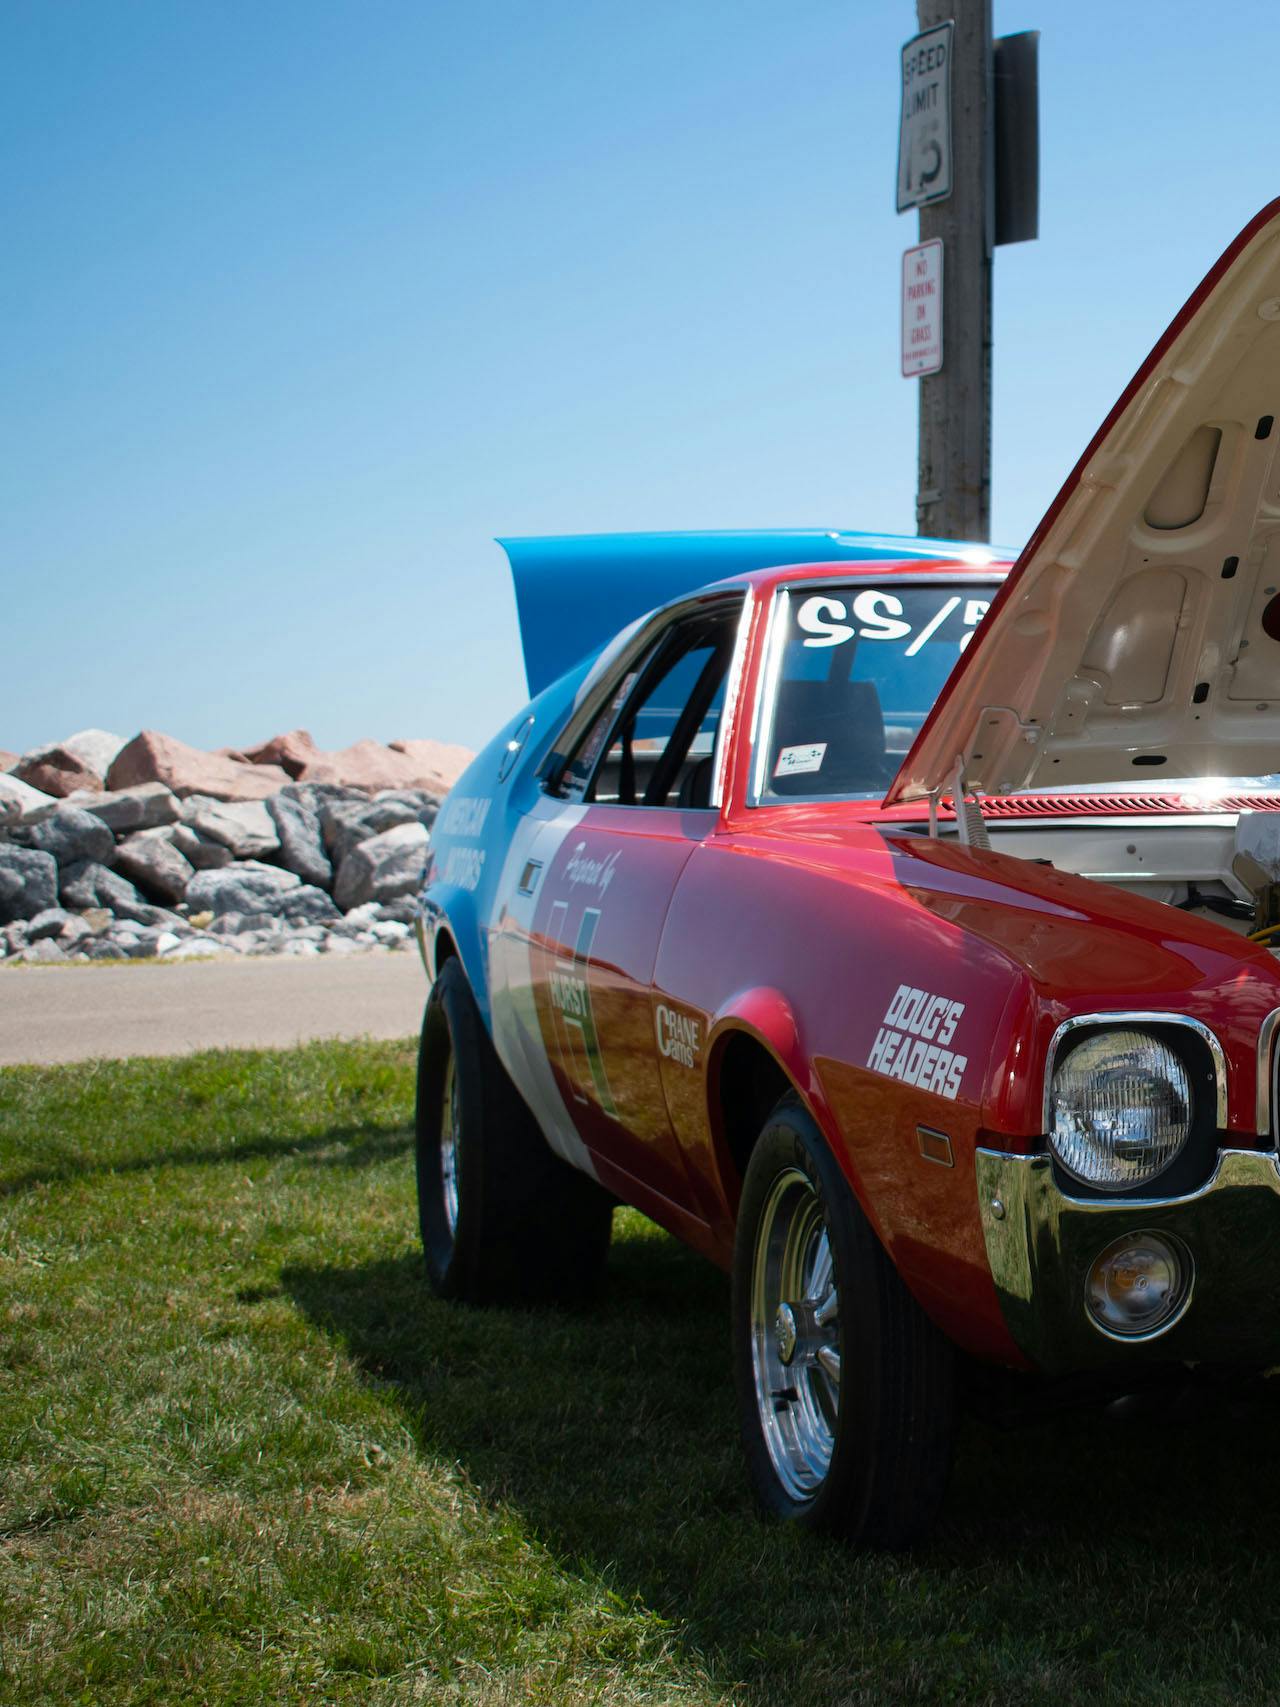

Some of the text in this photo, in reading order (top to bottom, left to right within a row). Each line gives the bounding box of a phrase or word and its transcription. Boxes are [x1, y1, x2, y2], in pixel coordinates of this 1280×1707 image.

[904, 43, 946, 85] SPEED
[906, 82, 938, 119] LIMIT
[551, 972, 588, 1018] HURST
[883, 984, 966, 1046] DOUG'S
[866, 1027, 968, 1100] HEADERS
